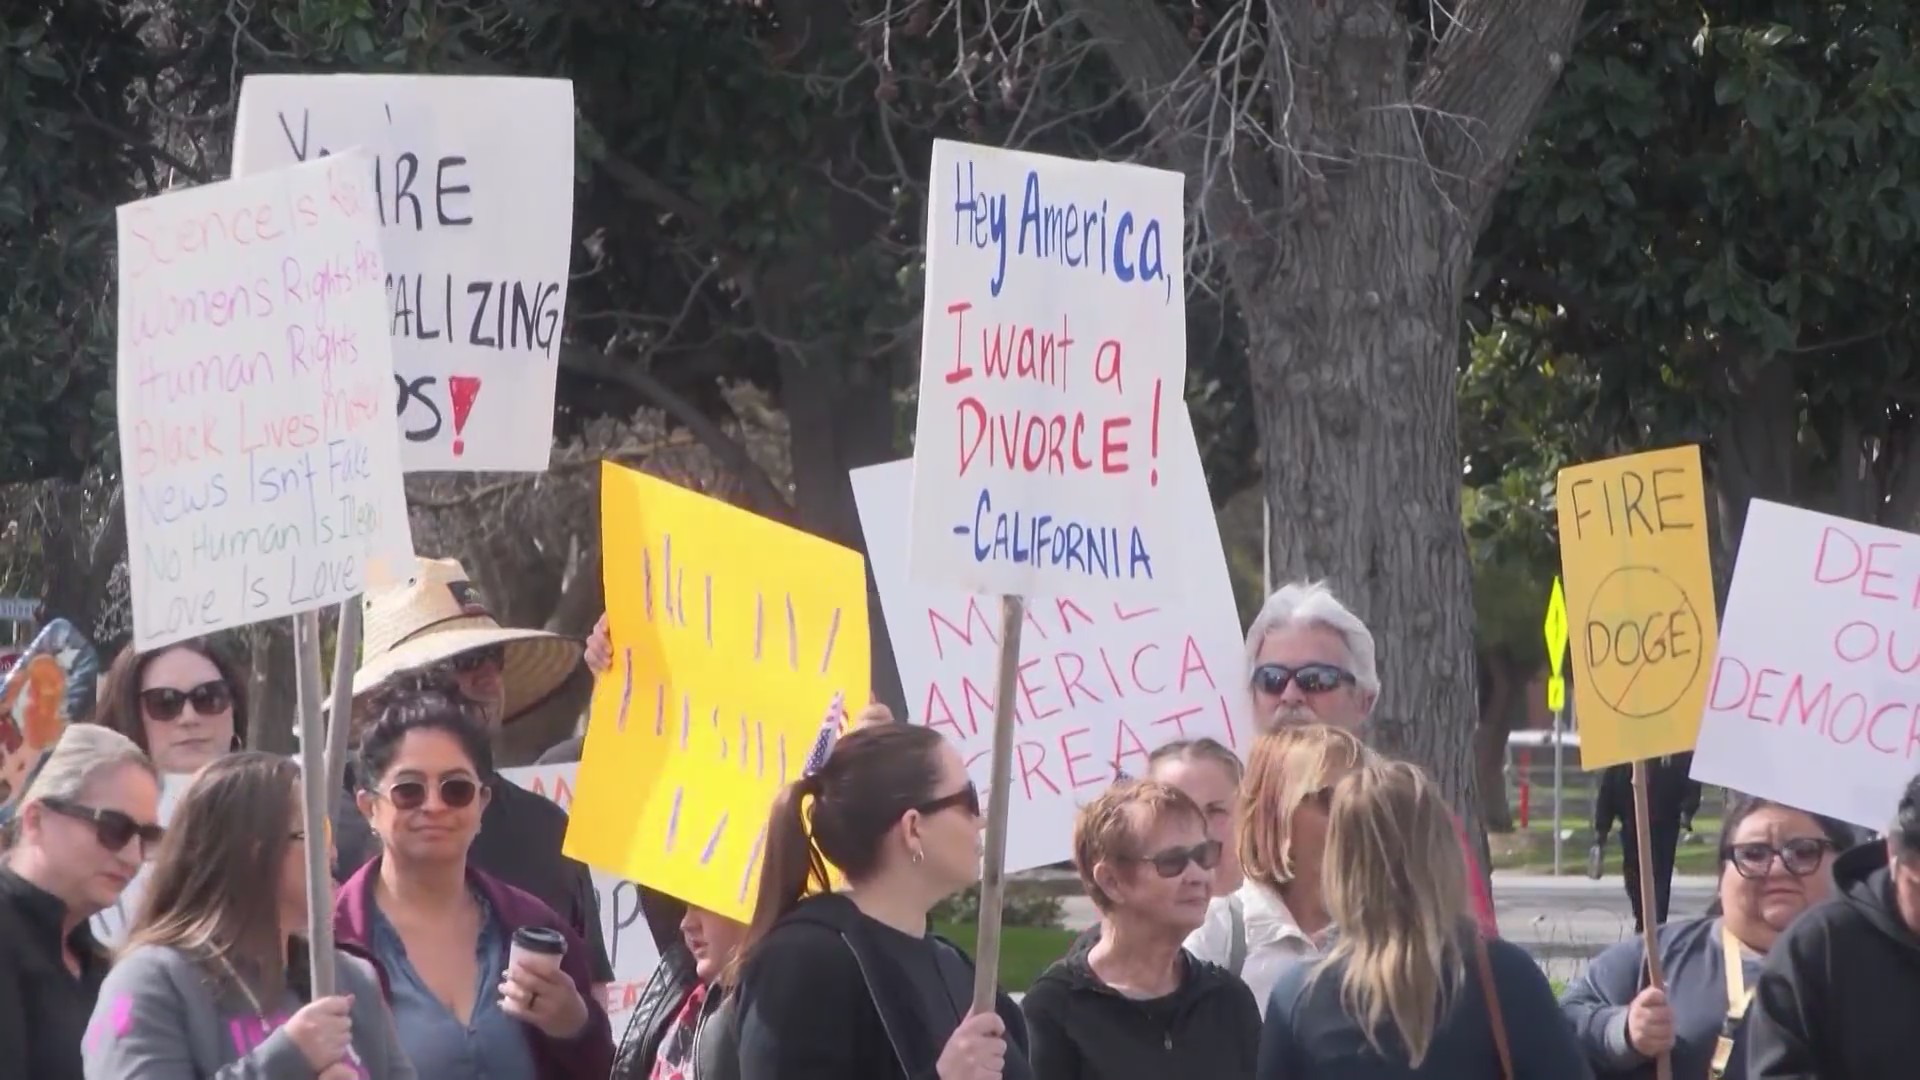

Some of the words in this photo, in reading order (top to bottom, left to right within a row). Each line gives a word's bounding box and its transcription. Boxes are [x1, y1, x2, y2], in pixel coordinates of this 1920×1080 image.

[954, 160, 1006, 298] Hey
[1018, 170, 1172, 306] America,
[281, 252, 352, 331] Rights
[386, 272, 559, 359] ALIZING
[138, 351, 274, 406] Human
[286, 324, 358, 394] Rights
[945, 302, 973, 384] I
[982, 312, 1075, 393] want
[1094, 339, 1123, 395] a
[134, 415, 225, 477] Black
[239, 399, 320, 454] Lives
[138, 472, 229, 527] News
[248, 448, 319, 504] Isn't
[327, 438, 371, 494] Fake
[1570, 467, 1695, 541] FIRE
[144, 540, 182, 582] No
[191, 521, 300, 567] Human
[311, 500, 333, 547] Is
[952, 489, 1154, 580] -CALIFORNIA
[144, 587, 222, 640] Love
[241, 563, 270, 613] Is
[290, 554, 358, 606] Love
[1587, 609, 1692, 669] DOGE
[924, 634, 1218, 740] AMERICA
